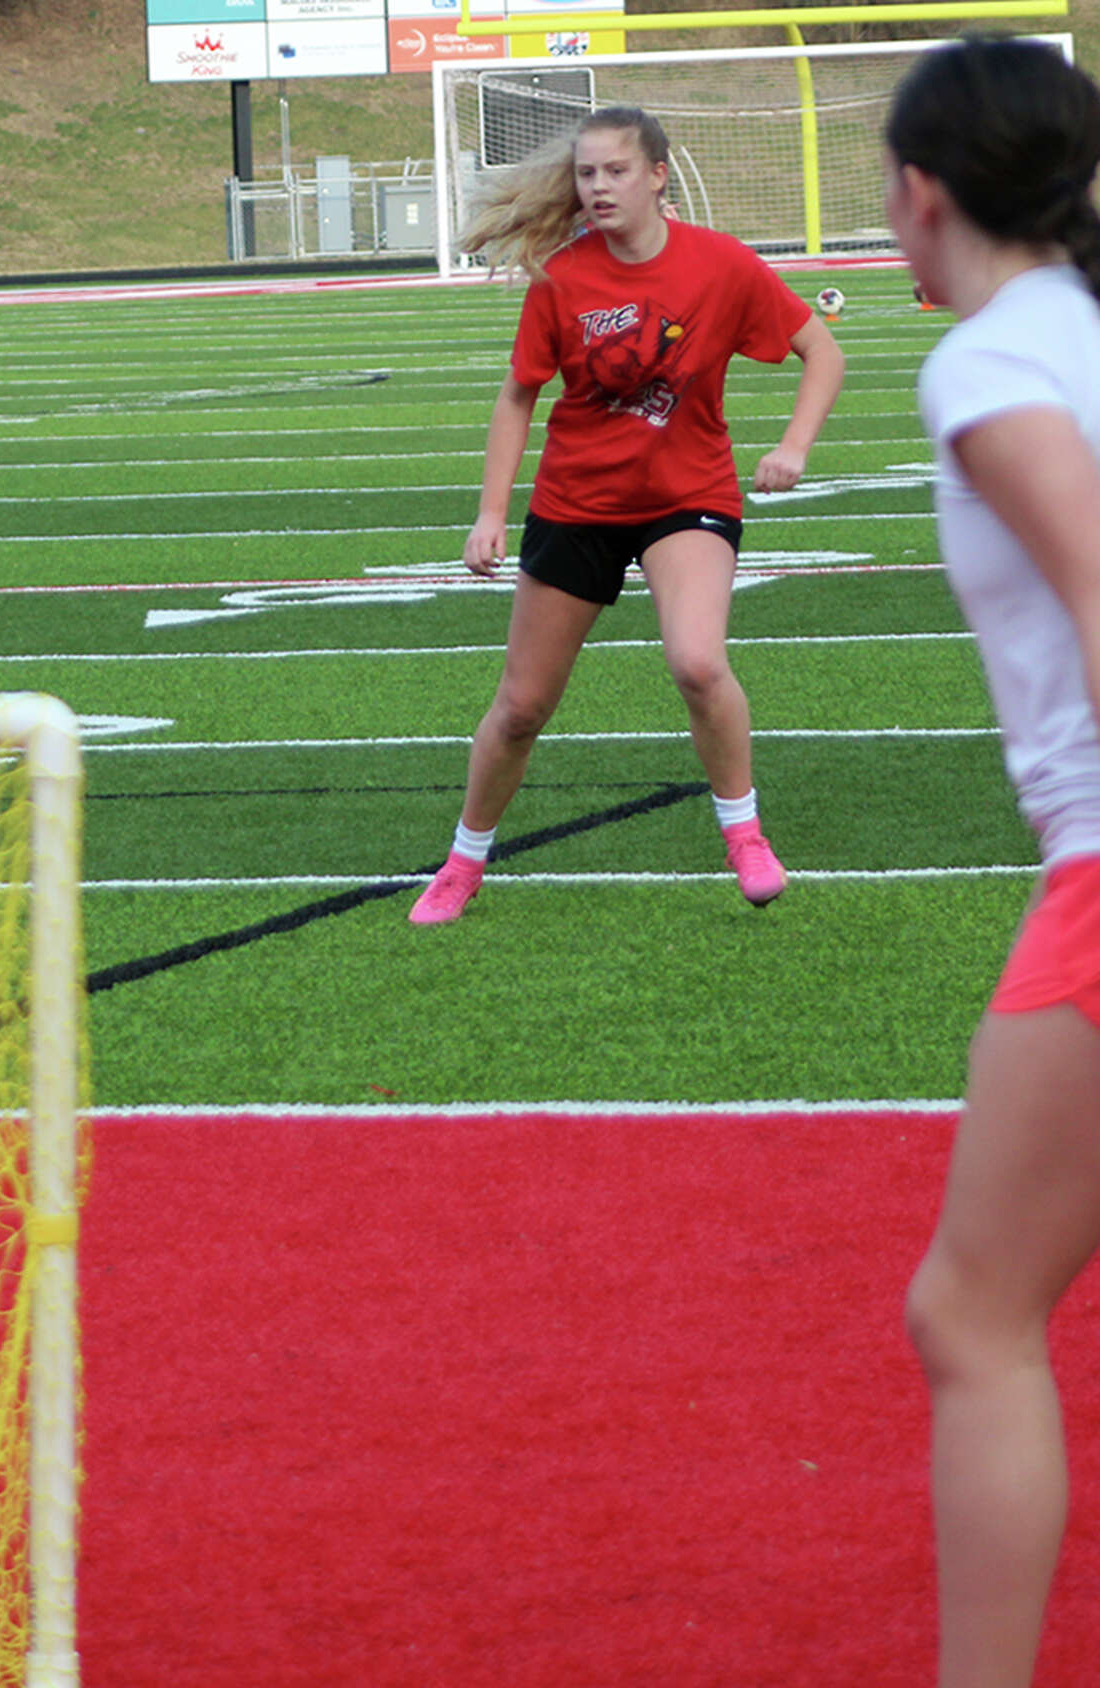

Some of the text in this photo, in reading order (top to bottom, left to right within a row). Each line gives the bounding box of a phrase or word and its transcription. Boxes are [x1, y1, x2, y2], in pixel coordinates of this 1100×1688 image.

[176, 51, 238, 64] SMOOTHIE
[190, 64, 223, 76] KING
[578, 303, 639, 346] THE
